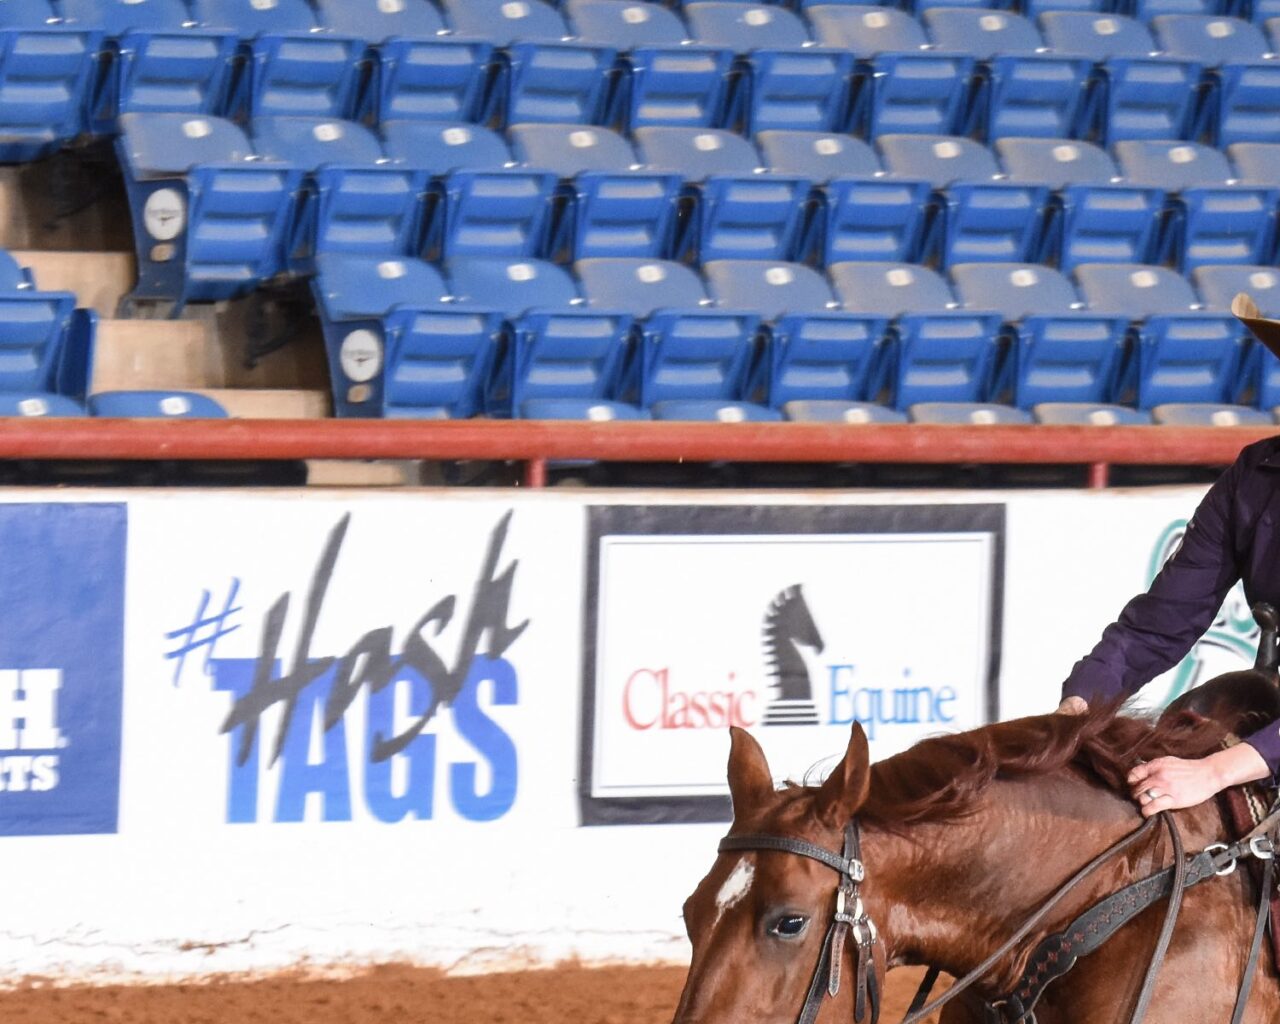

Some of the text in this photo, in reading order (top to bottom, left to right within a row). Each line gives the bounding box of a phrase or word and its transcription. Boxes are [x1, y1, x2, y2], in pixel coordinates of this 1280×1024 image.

[622, 667, 757, 731] Classic
[826, 664, 957, 741] Equine
[210, 652, 519, 824] TAGS
[0, 755, 60, 792] TS
